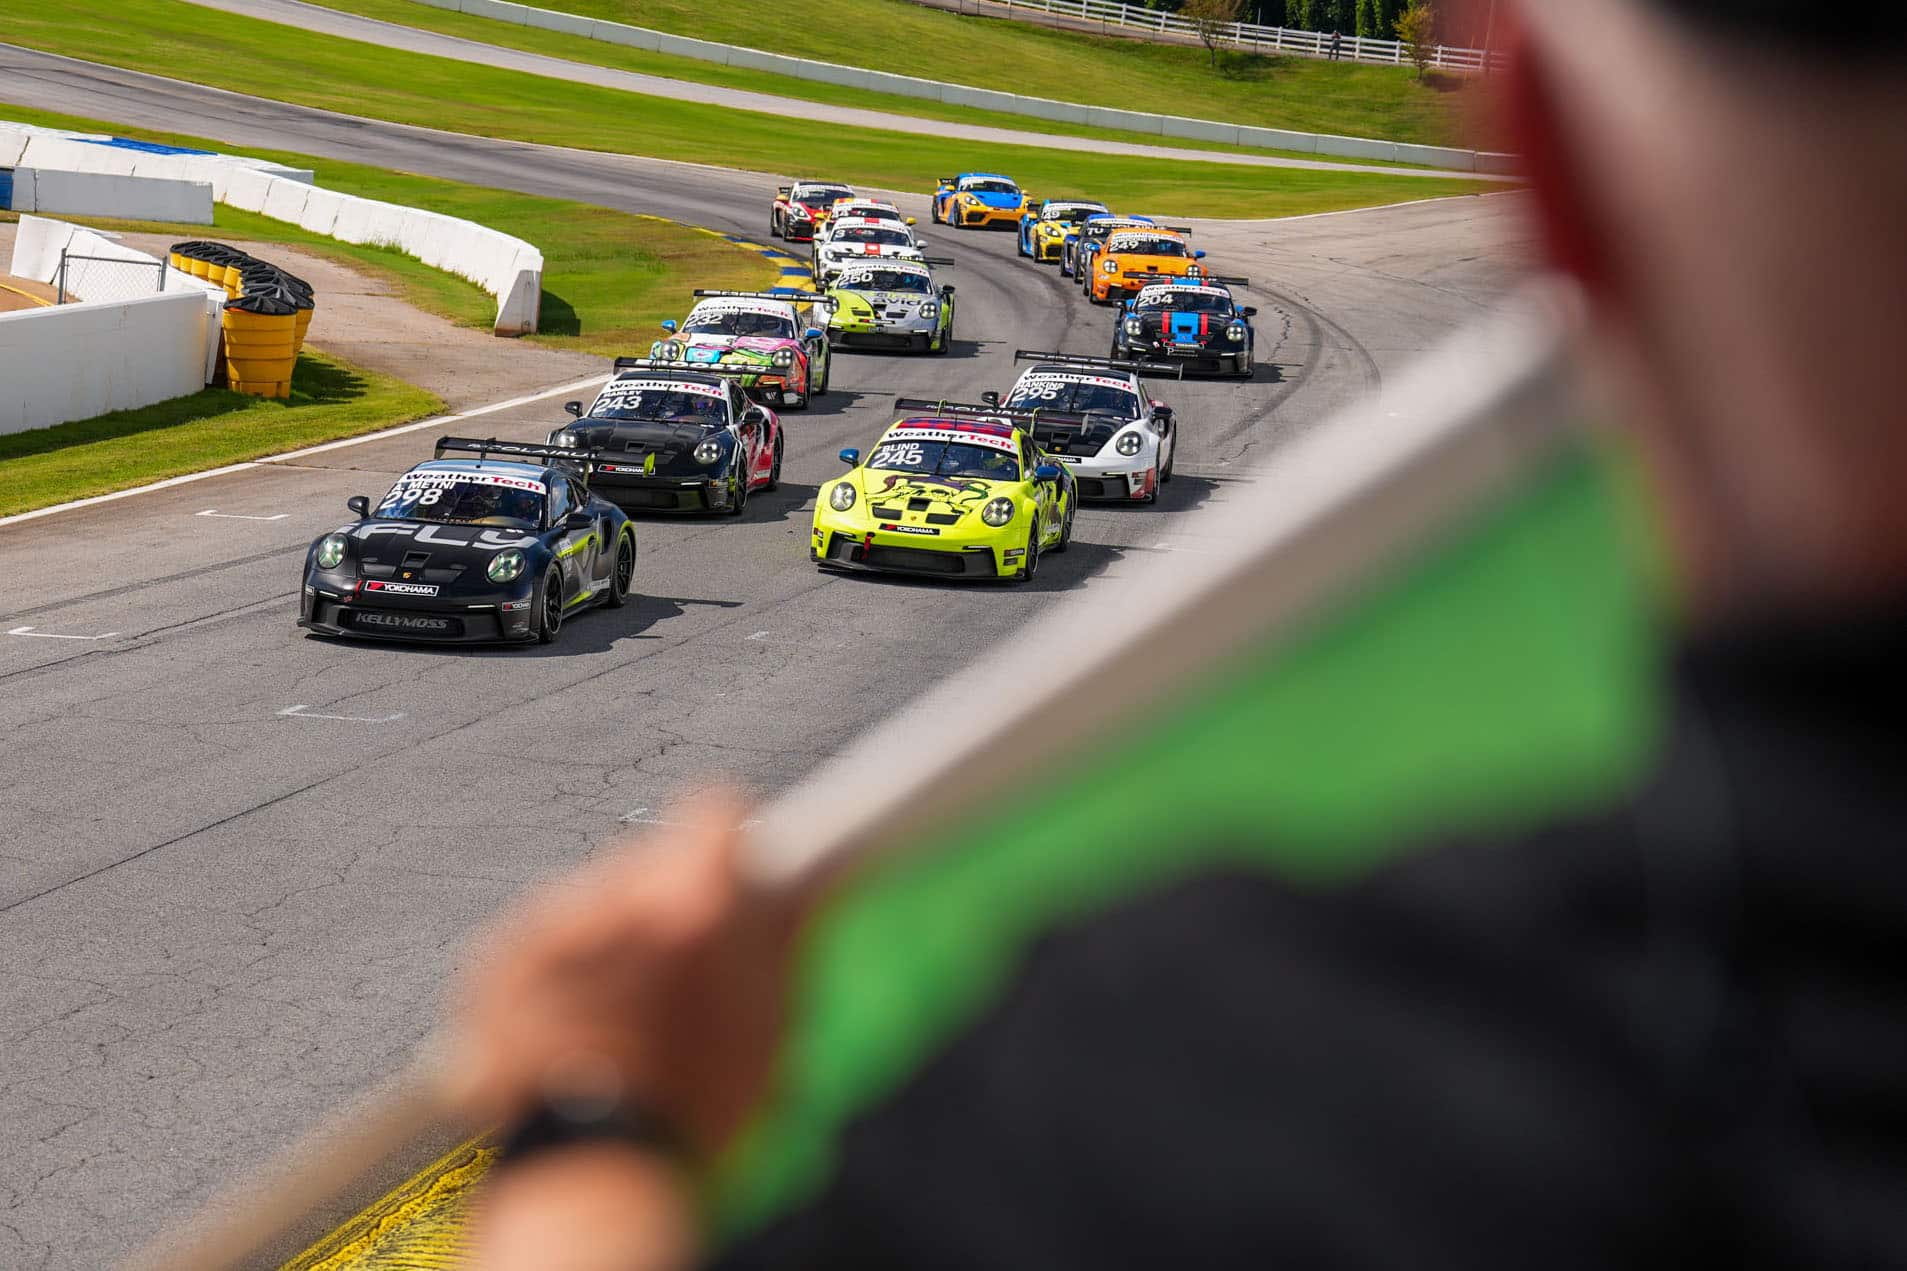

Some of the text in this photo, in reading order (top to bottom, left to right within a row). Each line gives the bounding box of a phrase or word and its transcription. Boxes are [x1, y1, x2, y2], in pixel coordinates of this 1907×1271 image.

[1109, 240, 1138, 252] 249
[1138, 294, 1174, 307] 204
[686, 314, 723, 328] 232
[609, 380, 723, 398] WeatherTech
[1024, 373, 1133, 391] WeatherTech
[1011, 387, 1057, 402] 295
[592, 396, 642, 413] 243
[882, 442, 920, 453] BLIND
[888, 430, 1012, 450] WeatherTech
[872, 450, 924, 468] 245
[406, 472, 541, 491] WeatherTech
[408, 480, 456, 491] METNI
[380, 488, 443, 510] 298
[352, 523, 540, 551] FLY
[896, 525, 935, 534] YOKOHAMA
[383, 583, 435, 595] YOKOHAMA
